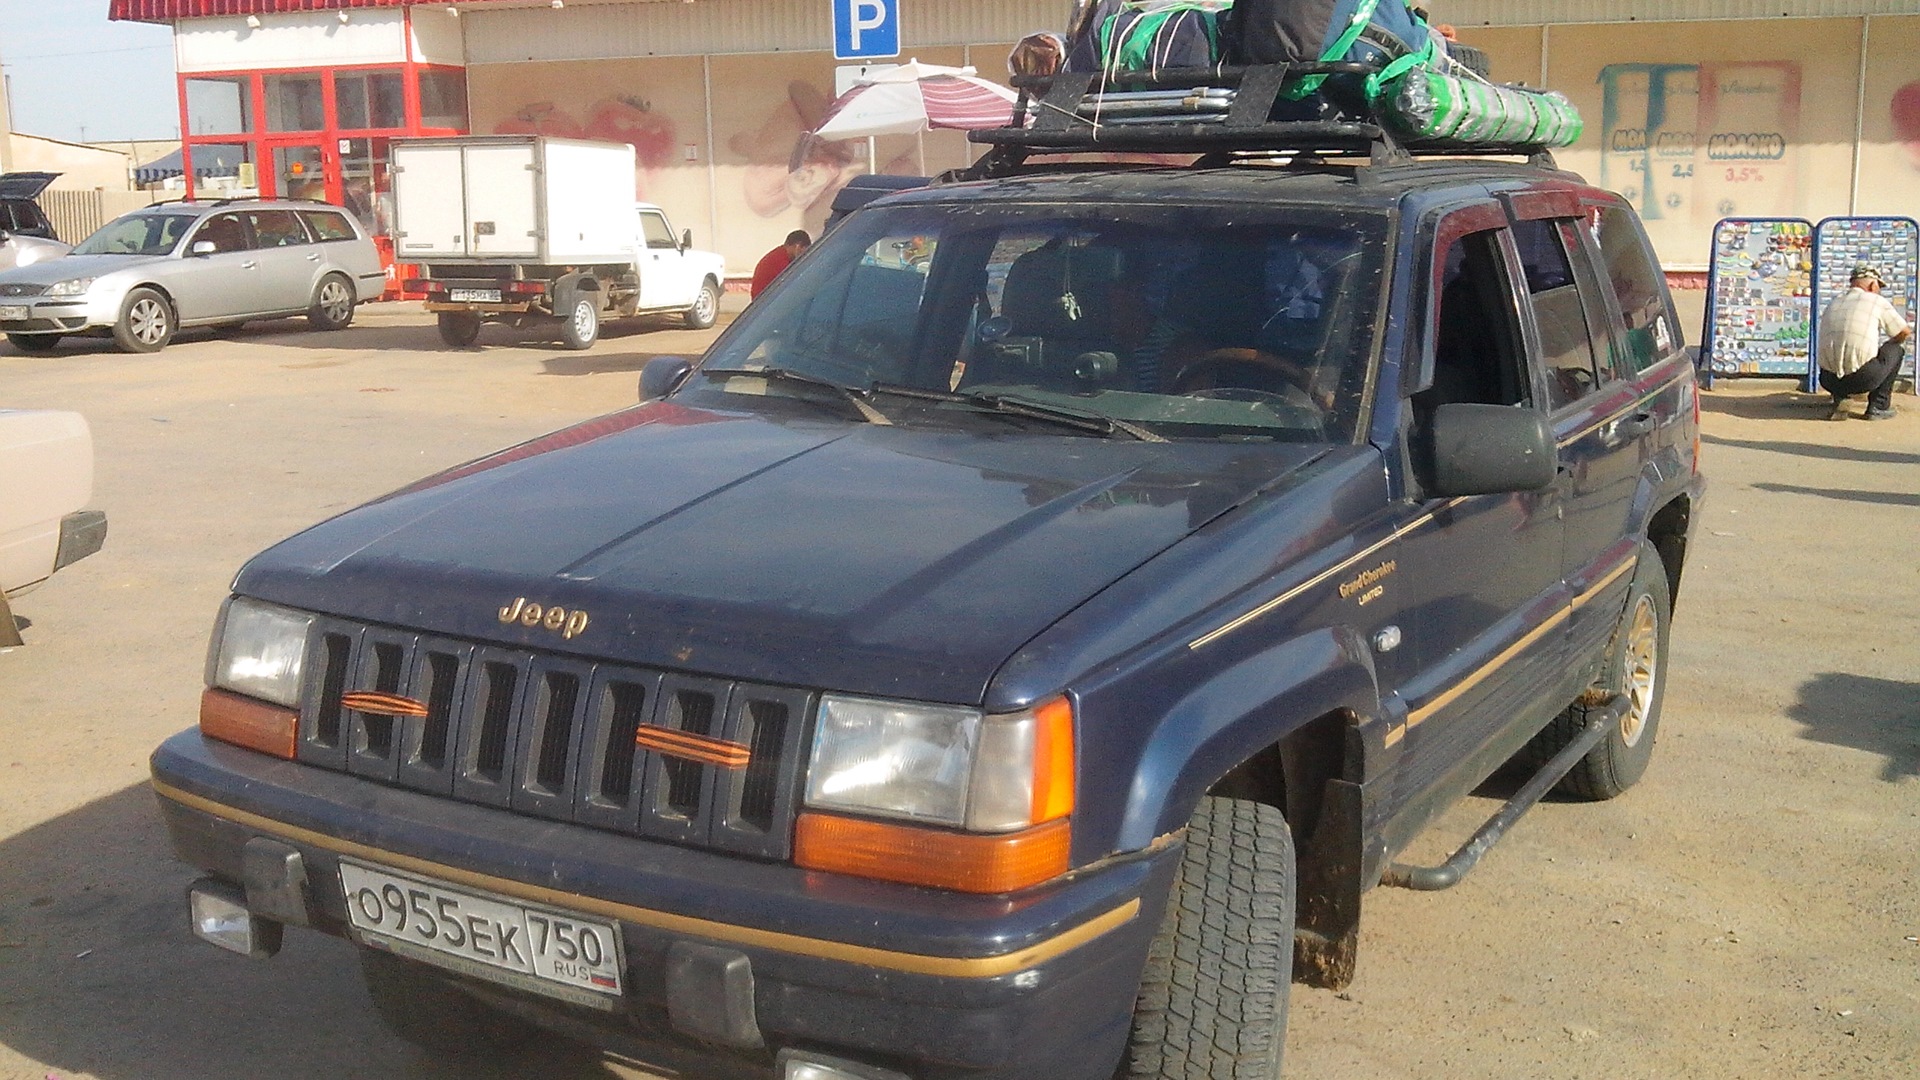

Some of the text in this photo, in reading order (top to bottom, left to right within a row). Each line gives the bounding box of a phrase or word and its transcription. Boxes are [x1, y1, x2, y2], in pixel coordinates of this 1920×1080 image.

[850, 0, 886, 50] P
[498, 597, 588, 639] Jeep
[528, 916, 602, 966] 750
[553, 960, 589, 980] RUS
